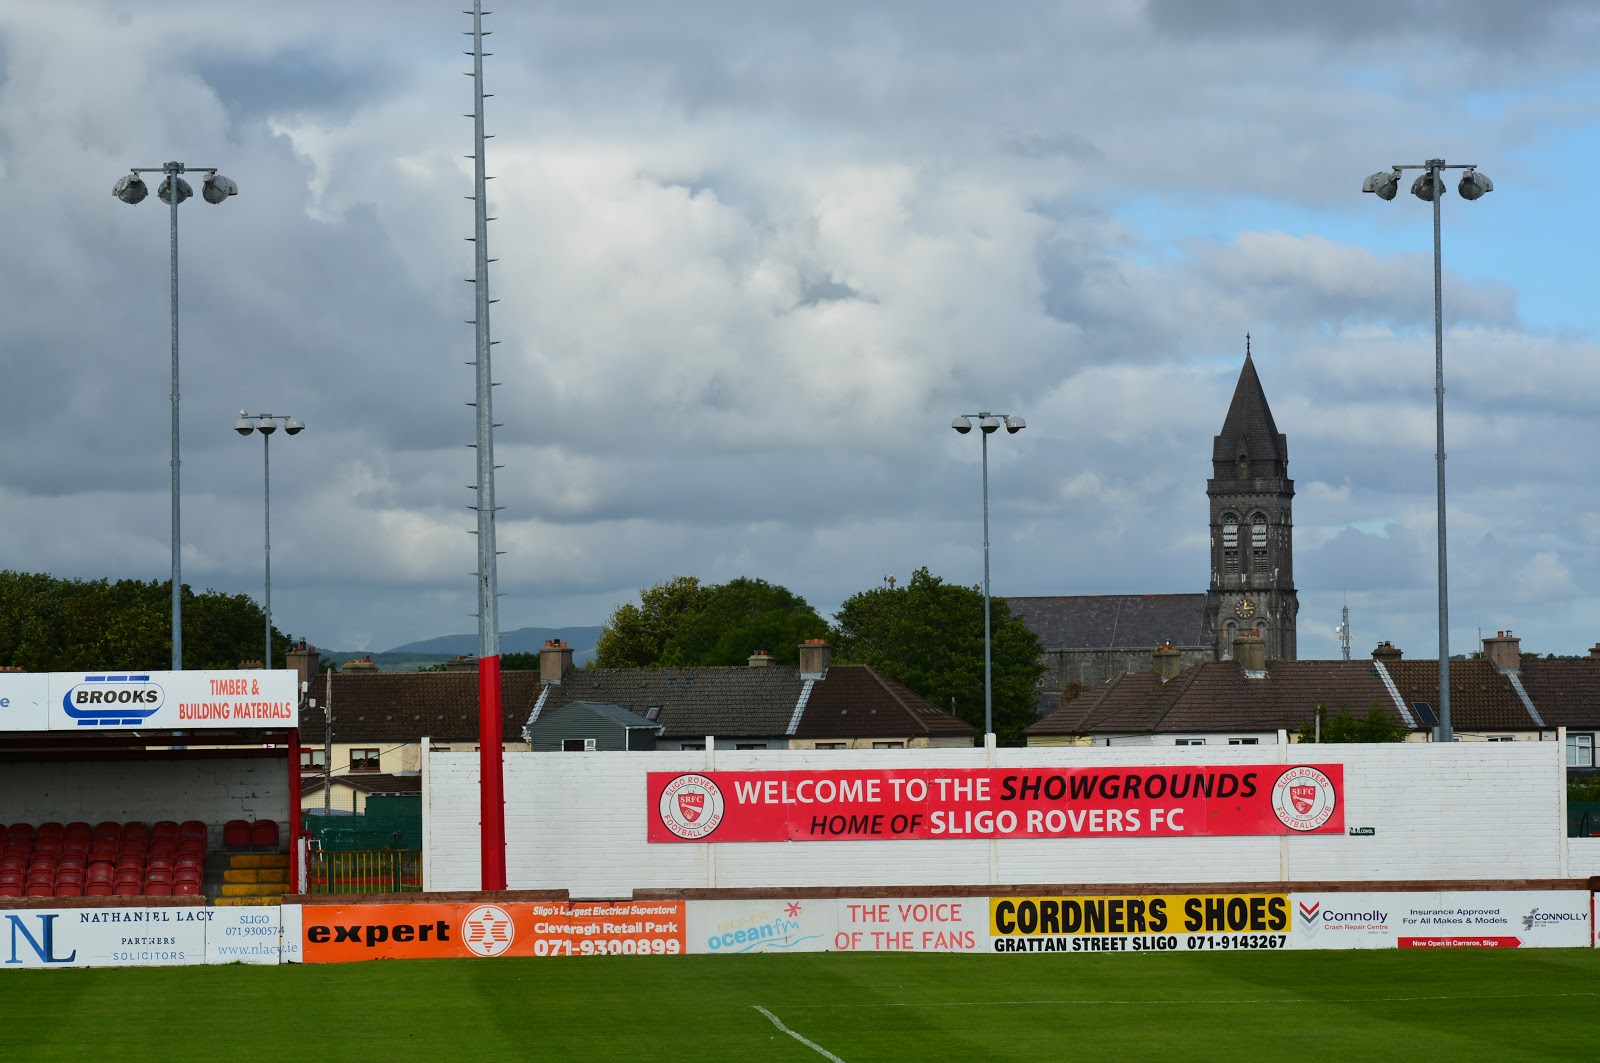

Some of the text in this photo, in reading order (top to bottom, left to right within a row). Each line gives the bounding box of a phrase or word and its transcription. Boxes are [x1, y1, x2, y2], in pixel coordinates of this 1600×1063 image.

[209, 679, 260, 696] TIMBER &
[76, 690, 158, 704] BROOKS
[179, 702, 291, 720] BUILDING MATERIALS
[665, 776, 718, 797] SLIGO ROVERS
[1277, 769, 1329, 789] SLIGO ROVERS
[734, 772, 1258, 804] WELCOME TO THE SHOWGROUNDS
[664, 813, 720, 837] FOOTBALL CLUB
[810, 807, 1185, 835] HOME OF SLIGO ROVERS FC
[1276, 805, 1332, 829] FOOTBALL CLUB
[80, 911, 215, 923] NATHANIEL LACY
[533, 904, 677, 917] Sligo's Largest Electrical Superstore!
[847, 903, 962, 923] THE VOICE
[995, 897, 1287, 934] CORDNERS SHOES
[1322, 910, 1388, 924] Connolly
[1410, 908, 1500, 917] Insurance Approved
[1534, 913, 1588, 921] CONNOLLY
[239, 915, 270, 925] SLIGO
[1344, 924, 1366, 932] Repair
[307, 920, 450, 947] expert
[534, 922, 678, 936] Cleveragh Retail Park
[4, 914, 77, 964] NL
[121, 937, 176, 945] PARTNERS
[834, 930, 976, 950] OF THE FANS
[994, 935, 1287, 952] GRATTAN STREET SLIGO 071-9143267
[1428, 940, 1445, 948] Open
[1483, 939, 1499, 948] Sligo
[113, 951, 185, 961] SOLICITORS
[218, 942, 298, 958] www.nlacy.ie
[534, 939, 680, 957] 071-9300899
